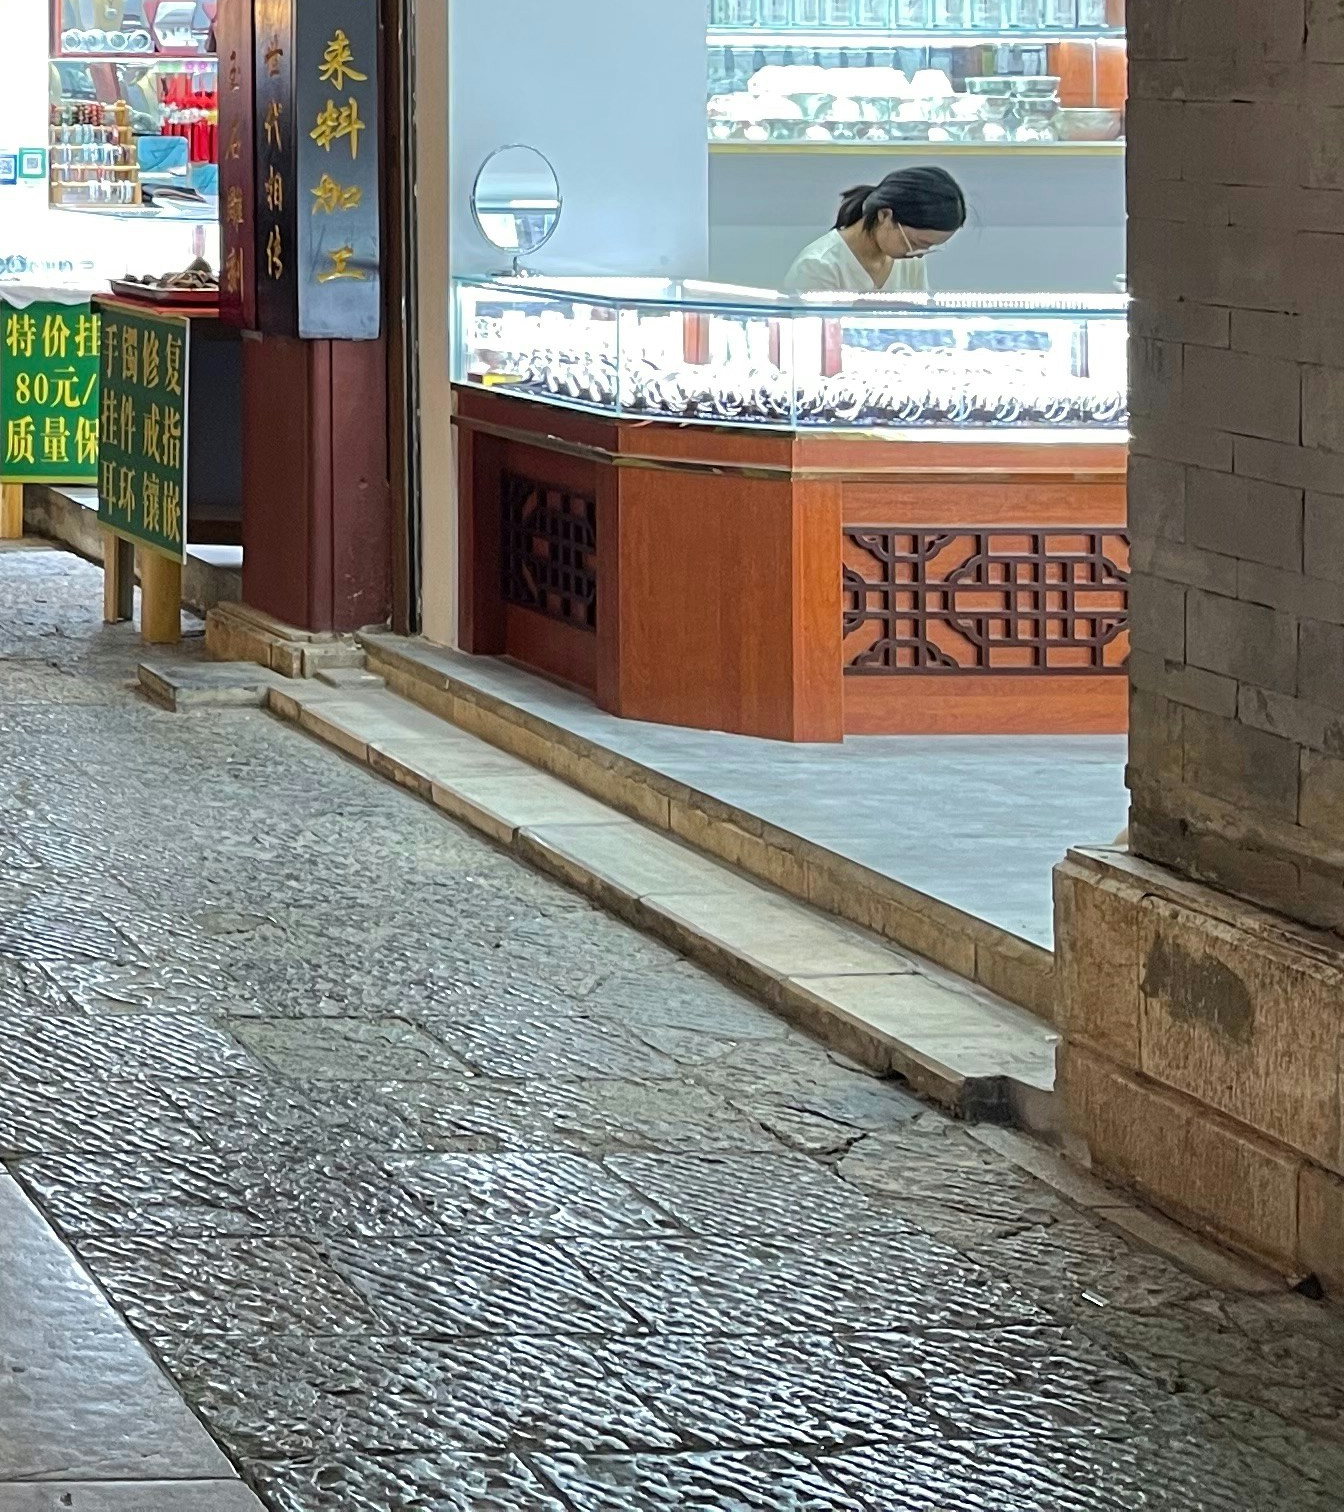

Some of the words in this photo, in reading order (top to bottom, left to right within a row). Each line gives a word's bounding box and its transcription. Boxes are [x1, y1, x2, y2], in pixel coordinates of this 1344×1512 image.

[309, 28, 369, 284] 来料加工
[15, 365, 97, 409] 80元/
[101, 386, 136, 455] 挂件
[142, 402, 181, 470] 戒指
[100, 458, 137, 523] 耳环
[141, 470, 181, 544] 镶嵌
